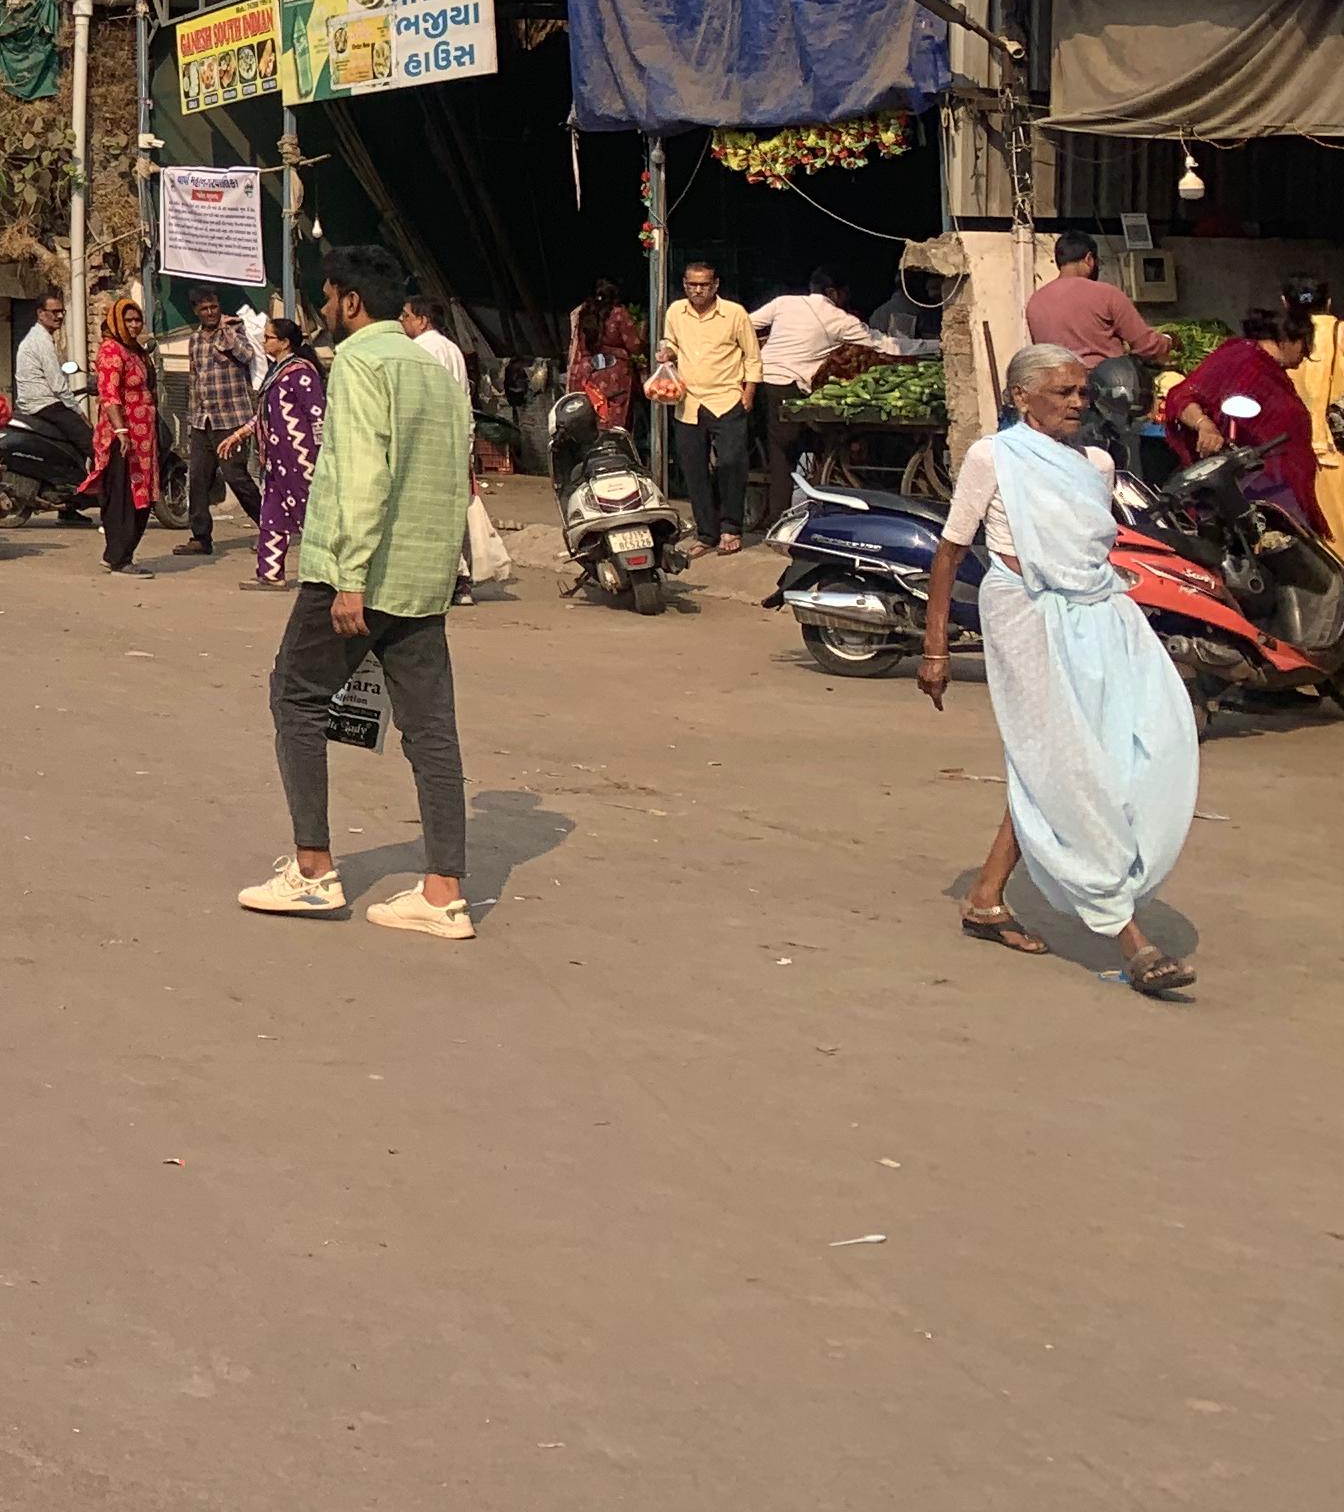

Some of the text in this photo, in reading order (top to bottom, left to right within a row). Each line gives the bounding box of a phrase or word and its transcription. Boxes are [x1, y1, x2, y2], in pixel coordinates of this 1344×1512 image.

[180, 6, 274, 57] GANESH SOUTH INDIAN
[395, 2, 481, 40] ભજીયા
[403, 40, 476, 78] હાઉસ
